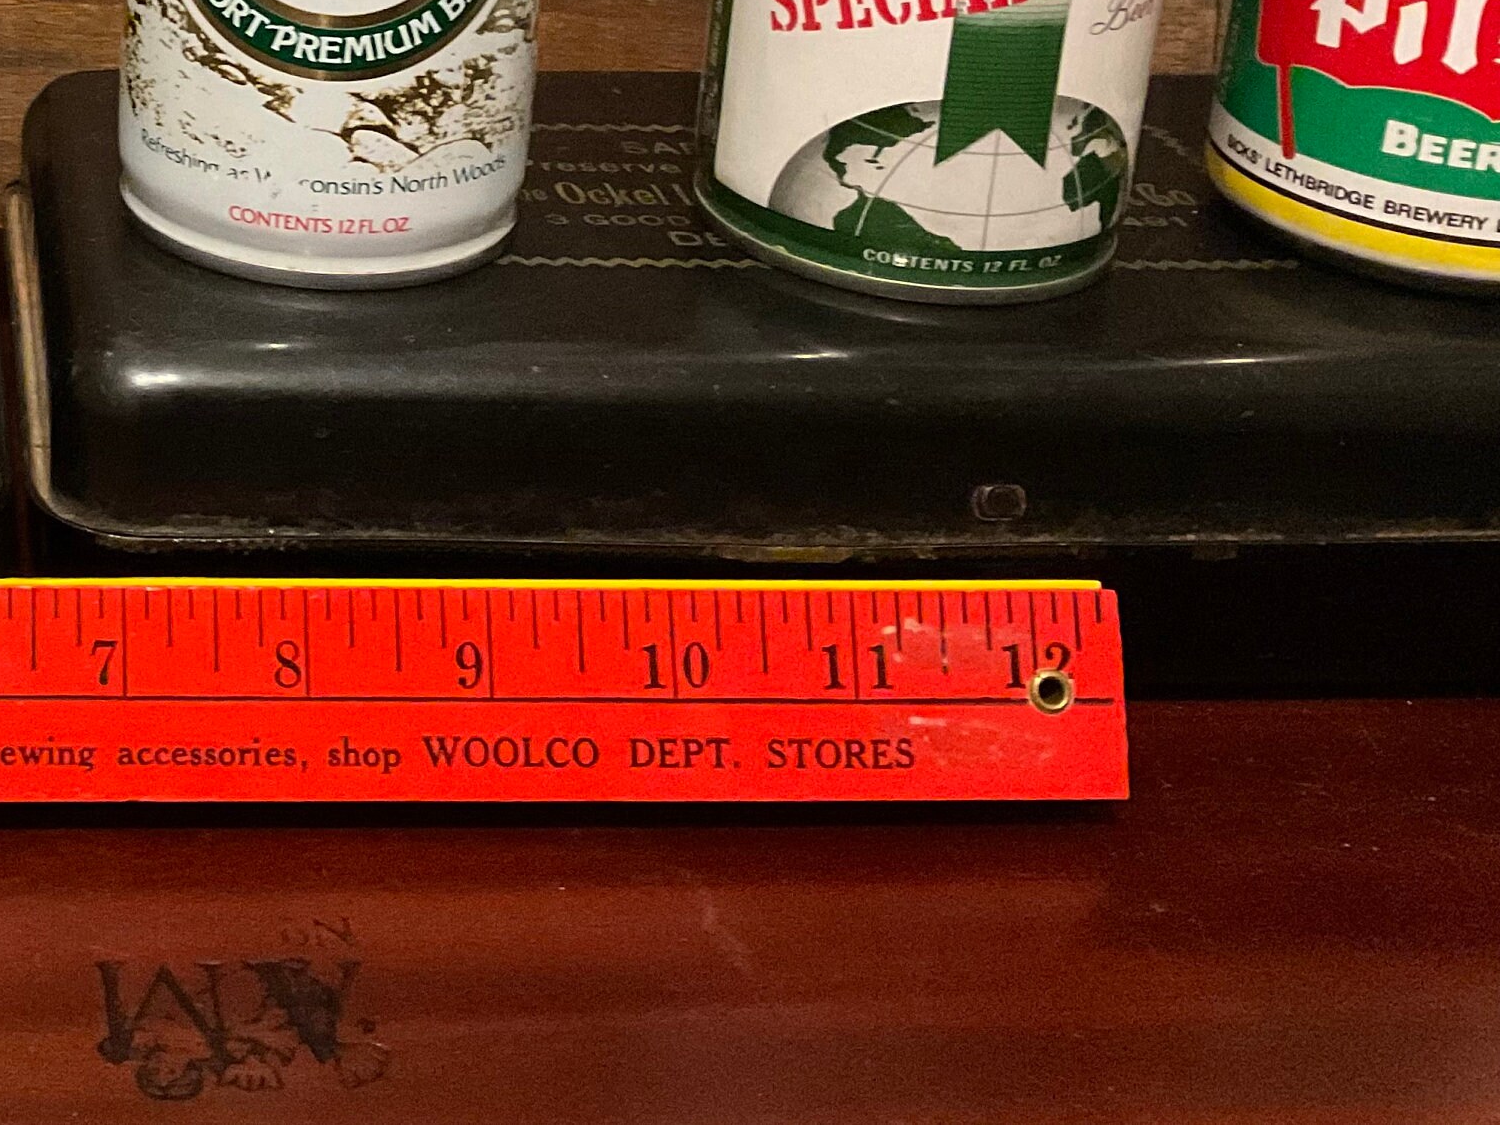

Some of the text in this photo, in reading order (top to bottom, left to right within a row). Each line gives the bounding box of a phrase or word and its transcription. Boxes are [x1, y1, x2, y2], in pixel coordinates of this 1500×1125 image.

[265, 11, 443, 65] PREMIUM
[1381, 119, 1500, 174] BEER
[390, 171, 448, 194] North
[1264, 157, 1375, 210] LETHBRIDGE
[1382, 198, 1490, 231] BREWERY
[228, 205, 333, 234] CONTENTS
[338, 218, 355, 235] 12
[90, 639, 118, 687] 7
[272, 639, 302, 690] 8
[454, 640, 483, 690] 9
[641, 641, 710, 690] 10
[820, 643, 894, 691] 11
[117, 736, 308, 773] accessories,
[327, 736, 402, 775] shop
[421, 735, 601, 770] WOOLCO
[628, 736, 742, 770] DEPT.
[766, 737, 916, 770] STORES
